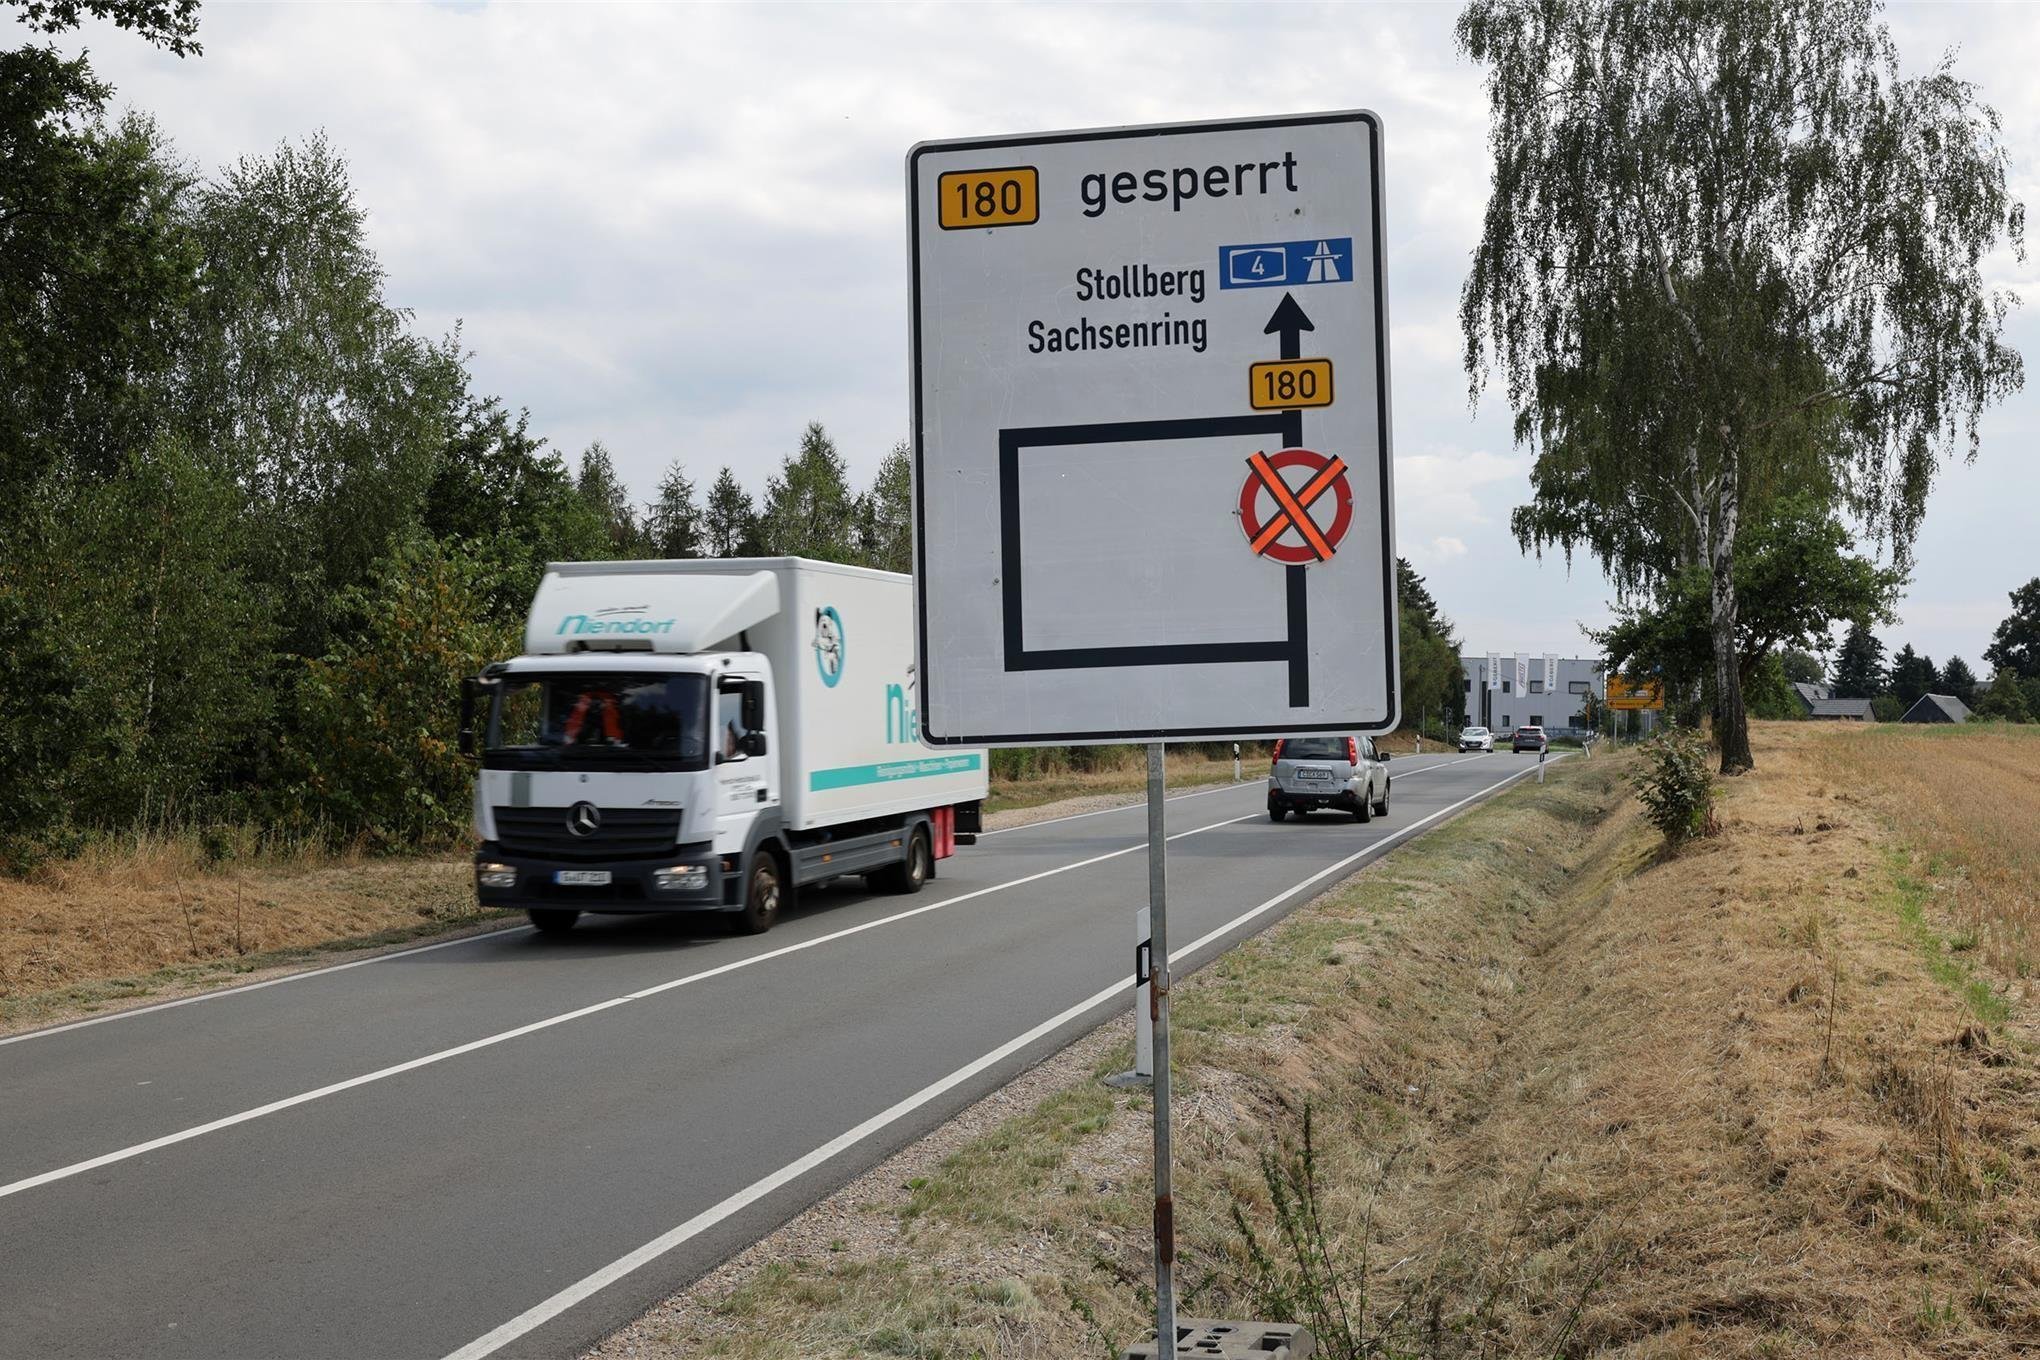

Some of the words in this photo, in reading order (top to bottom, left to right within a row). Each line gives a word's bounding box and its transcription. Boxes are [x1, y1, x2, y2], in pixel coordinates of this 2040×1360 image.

[956, 179, 1023, 219] 180
[1080, 151, 1298, 218] gesperrt
[1076, 263, 1206, 304] Stollberg
[1251, 255, 1265, 275] 4
[1028, 312, 1208, 354] Sachsenring
[1264, 369, 1317, 402] 180
